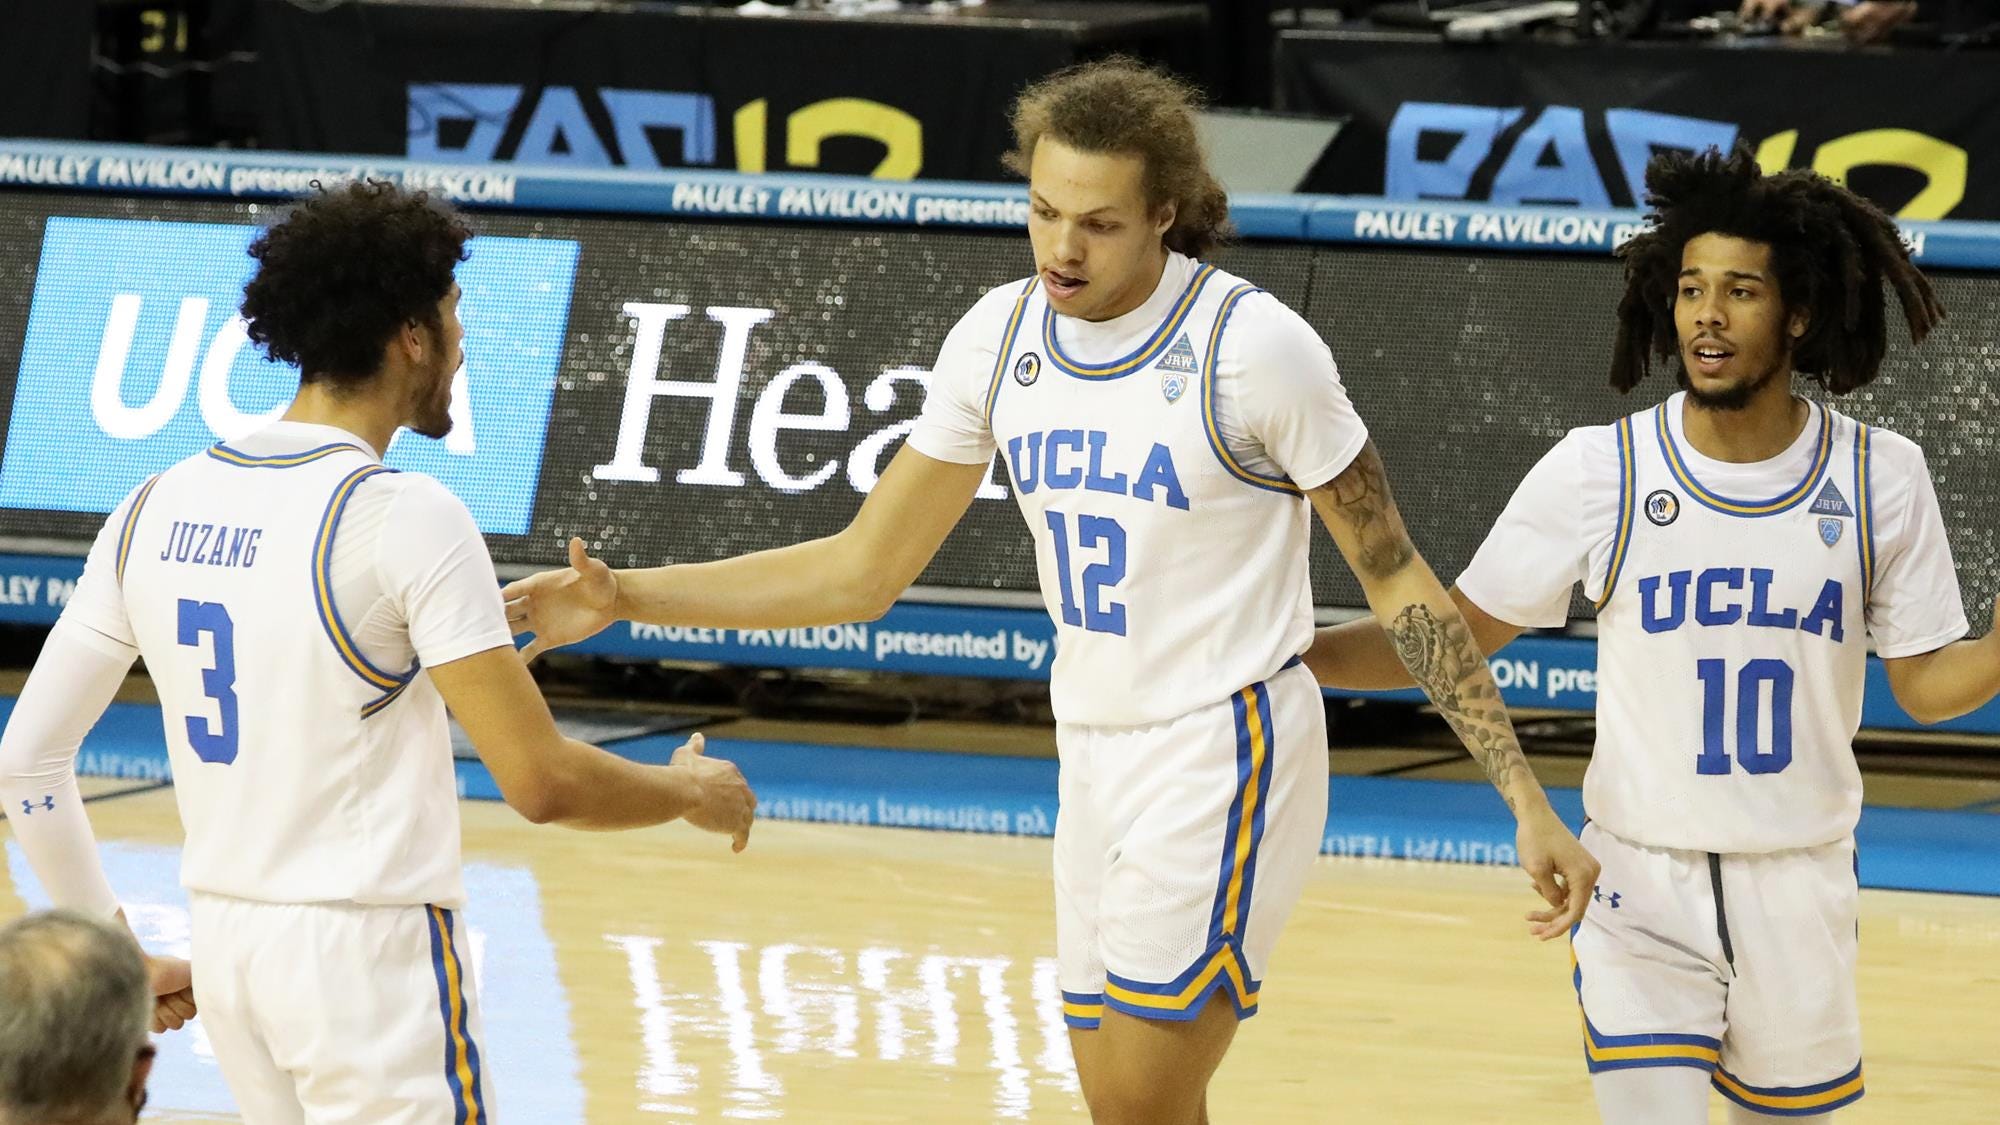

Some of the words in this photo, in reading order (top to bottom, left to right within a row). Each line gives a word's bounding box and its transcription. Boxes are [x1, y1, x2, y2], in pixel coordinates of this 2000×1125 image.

[97, 157, 228, 190] PAVILION
[672, 182, 770, 211] PAULEY
[778, 185, 911, 219] PAVILION
[915, 196, 1029, 226] presente
[1354, 210, 1459, 240] PAULEY
[1467, 214, 1608, 246] PAVILION
[1008, 429, 1190, 511] UCLA
[160, 520, 263, 569] JUZANG
[1045, 510, 1127, 637] 12
[1637, 567, 1845, 643] UCLA
[737, 622, 868, 652] PAVILION
[875, 629, 1007, 662] presented
[1012, 629, 1049, 670] by
[177, 598, 240, 765] 3
[1696, 658, 1794, 776] 10
